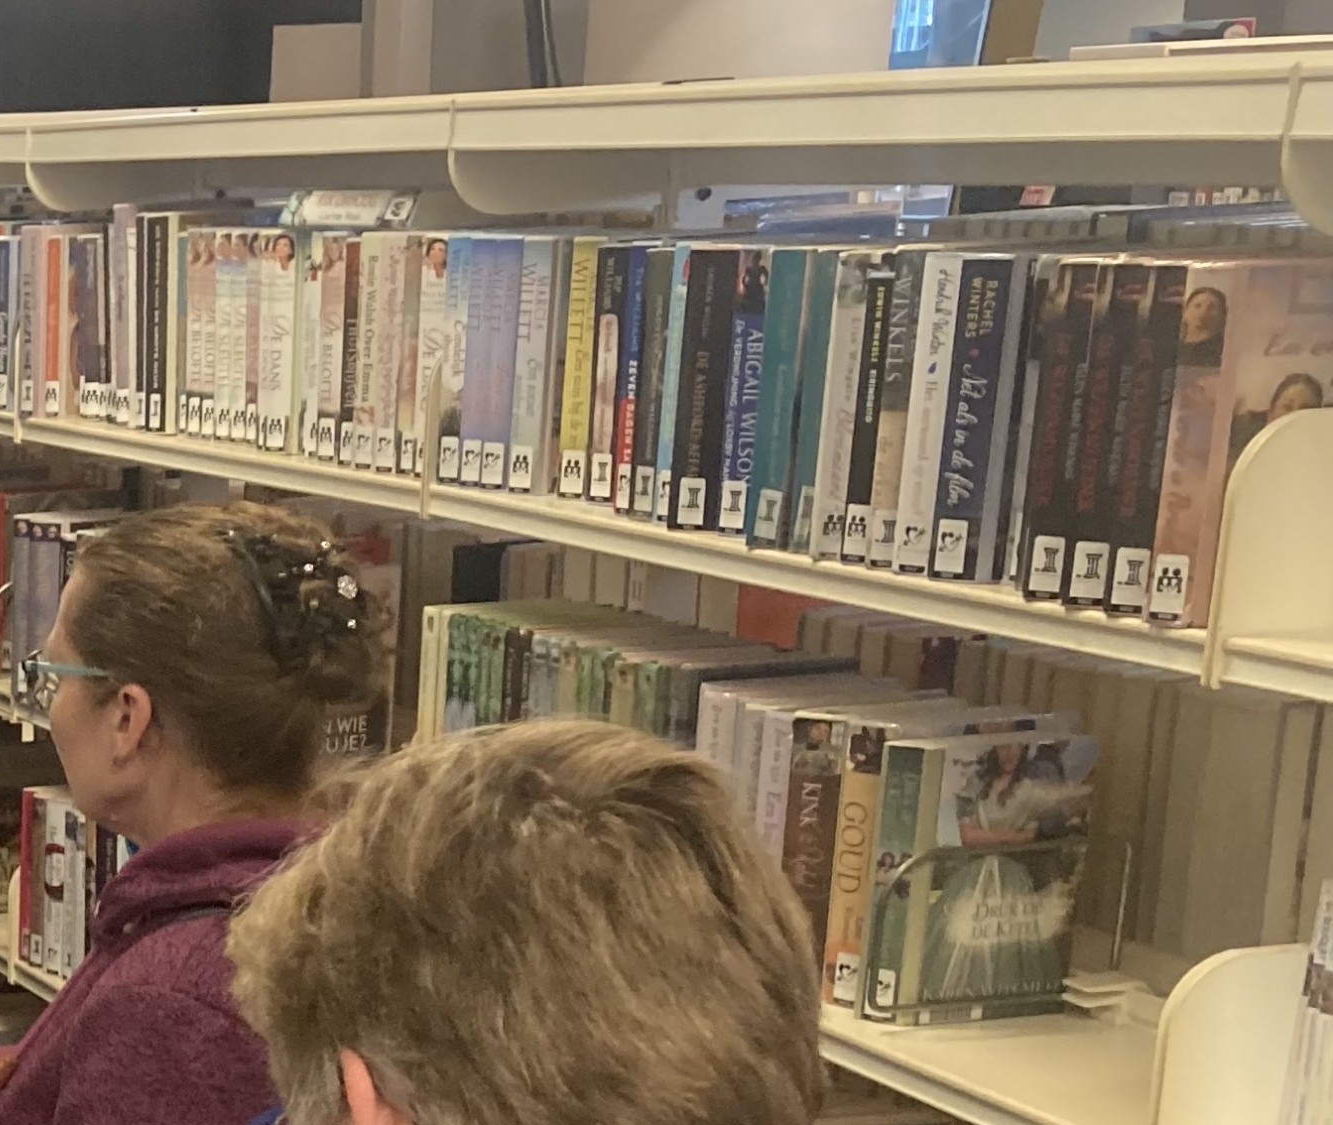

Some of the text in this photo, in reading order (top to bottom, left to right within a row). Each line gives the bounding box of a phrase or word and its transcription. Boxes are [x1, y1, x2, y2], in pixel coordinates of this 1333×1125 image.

[365, 289, 377, 326] Walsh
[516, 262, 538, 344] WILLETT
[569, 258, 591, 343] WILLETT
[965, 276, 983, 338] WINTERS
[979, 280, 999, 336] RACHEL
[363, 328, 374, 358] Over
[871, 320, 882, 362] WINKELS
[885, 277, 913, 382] WINKELS
[270, 349, 283, 392] DANS
[321, 343, 333, 403] BELOFTE
[627, 360, 637, 400] ZEVEN
[695, 351, 711, 369] DE
[742, 328, 764, 404] ABIGAIL
[361, 363, 373, 403] Emma
[623, 404, 635, 444] DAGEN
[944, 364, 989, 507] Net als in de film
[337, 714, 367, 734] WIE
[836, 801, 867, 894] GOUD
[975, 902, 1019, 922] DRUK
